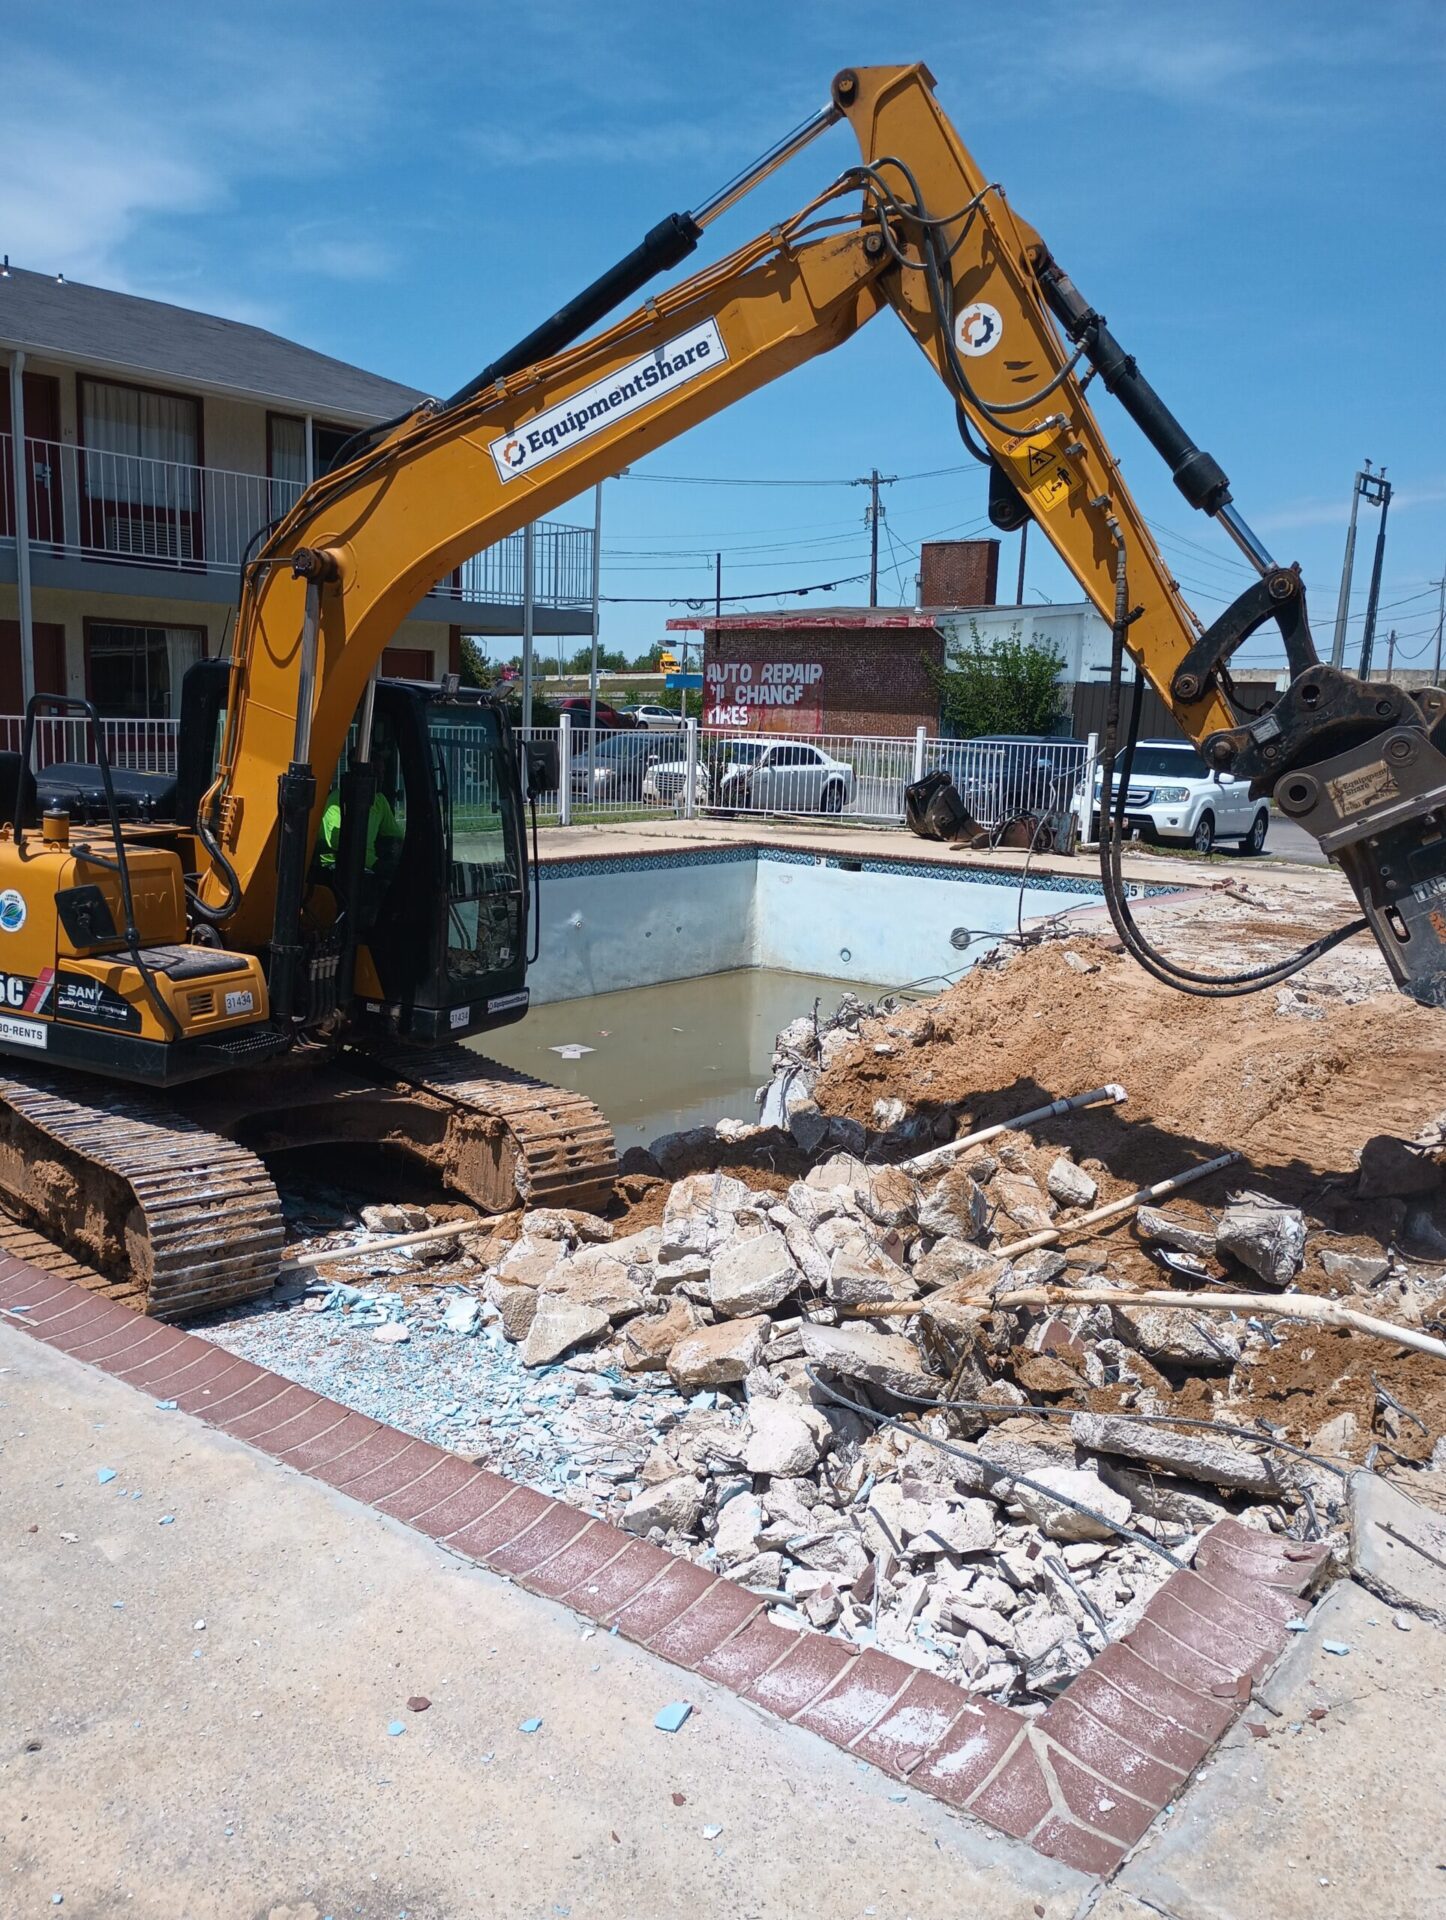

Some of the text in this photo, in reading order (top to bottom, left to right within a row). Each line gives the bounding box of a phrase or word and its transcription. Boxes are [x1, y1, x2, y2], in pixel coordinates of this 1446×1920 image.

[525, 338, 711, 454] EquipmentShare
[706, 663, 752, 683] AUTO
[735, 685, 804, 704] CHANGE
[707, 705, 748, 726] TIRES
[816, 855, 821, 865] 5
[1130, 885, 1138, 897] 5
[67, 984, 103, 1001] SANY
[226, 992, 252, 1009] 31434
[450, 1011, 469, 1024] 31434
